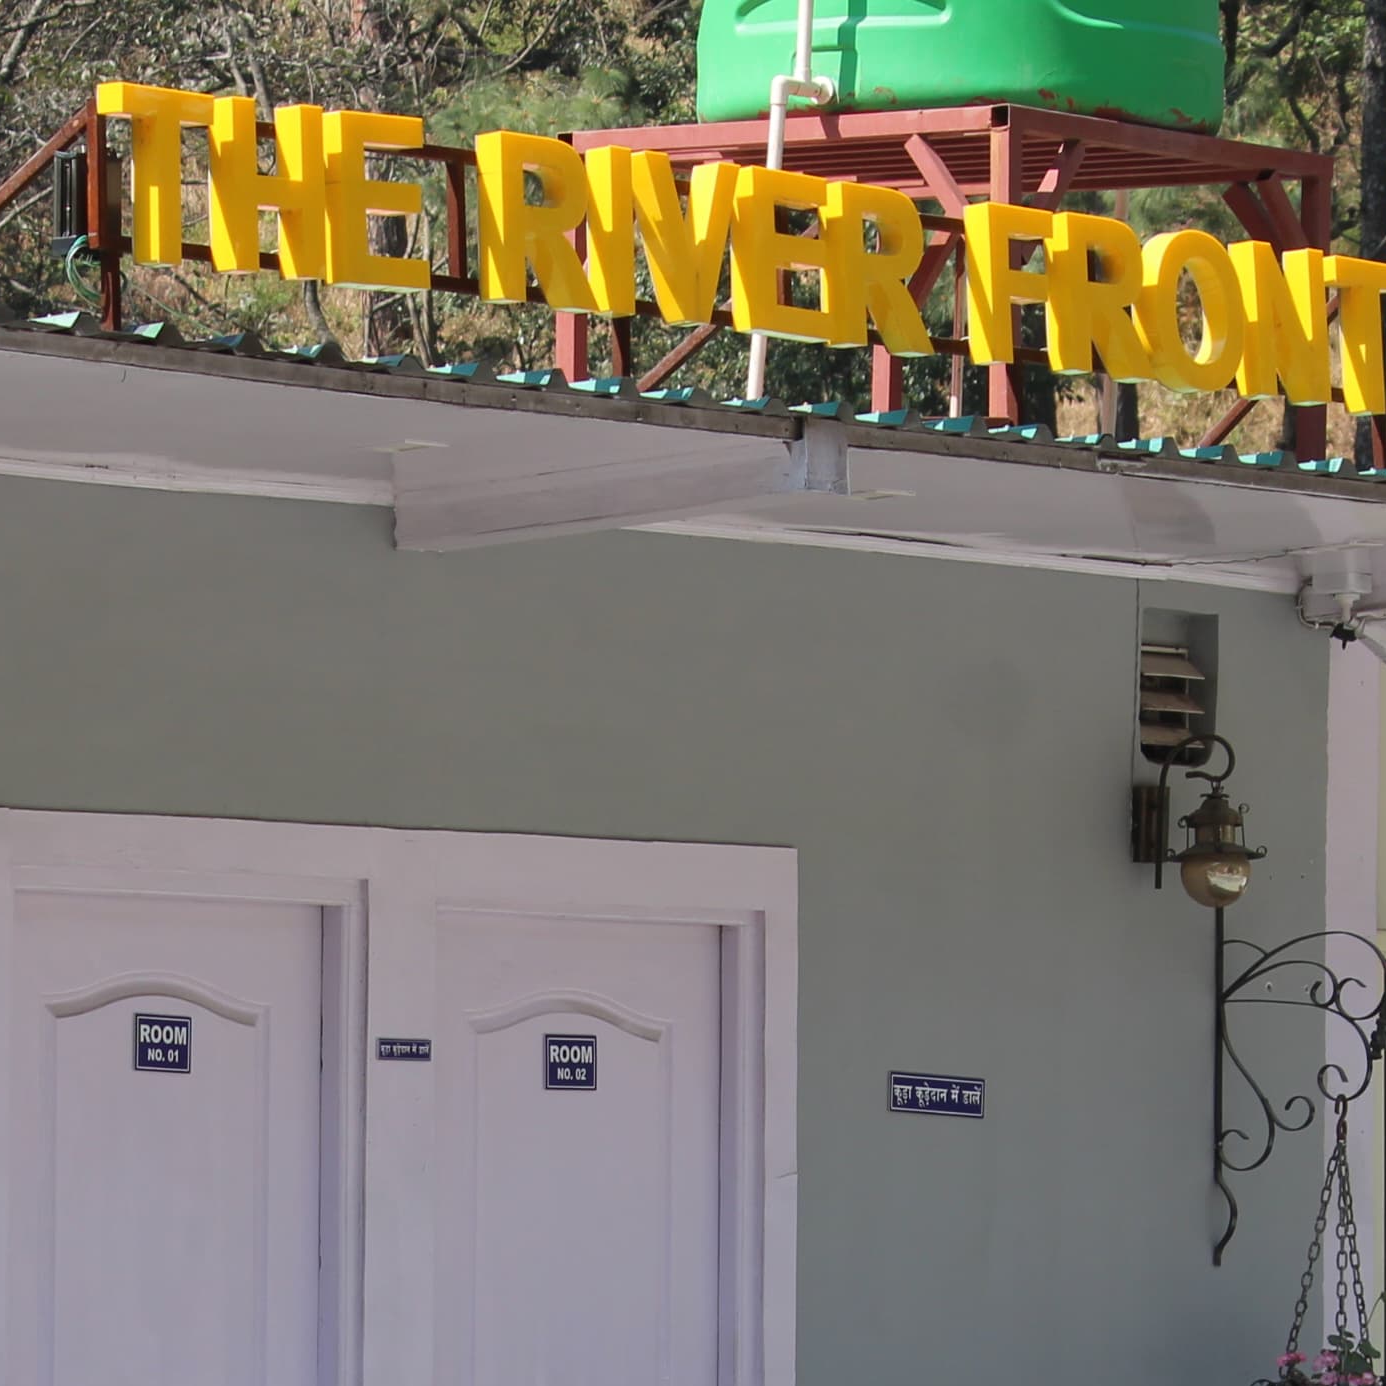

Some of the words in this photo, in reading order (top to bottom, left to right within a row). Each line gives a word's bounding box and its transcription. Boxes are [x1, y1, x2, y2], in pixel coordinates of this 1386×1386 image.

[97, 81, 431, 293] THE
[475, 130, 934, 358] RIVER
[140, 1023, 187, 1046] ROOM
[147, 1048, 165, 1063] NO.
[167, 1049, 179, 1063] 01
[550, 1045, 593, 1064] ROOM
[557, 1067, 574, 1081] NO.
[575, 1068, 587, 1081] 02
[950, 1084, 960, 1104] में
